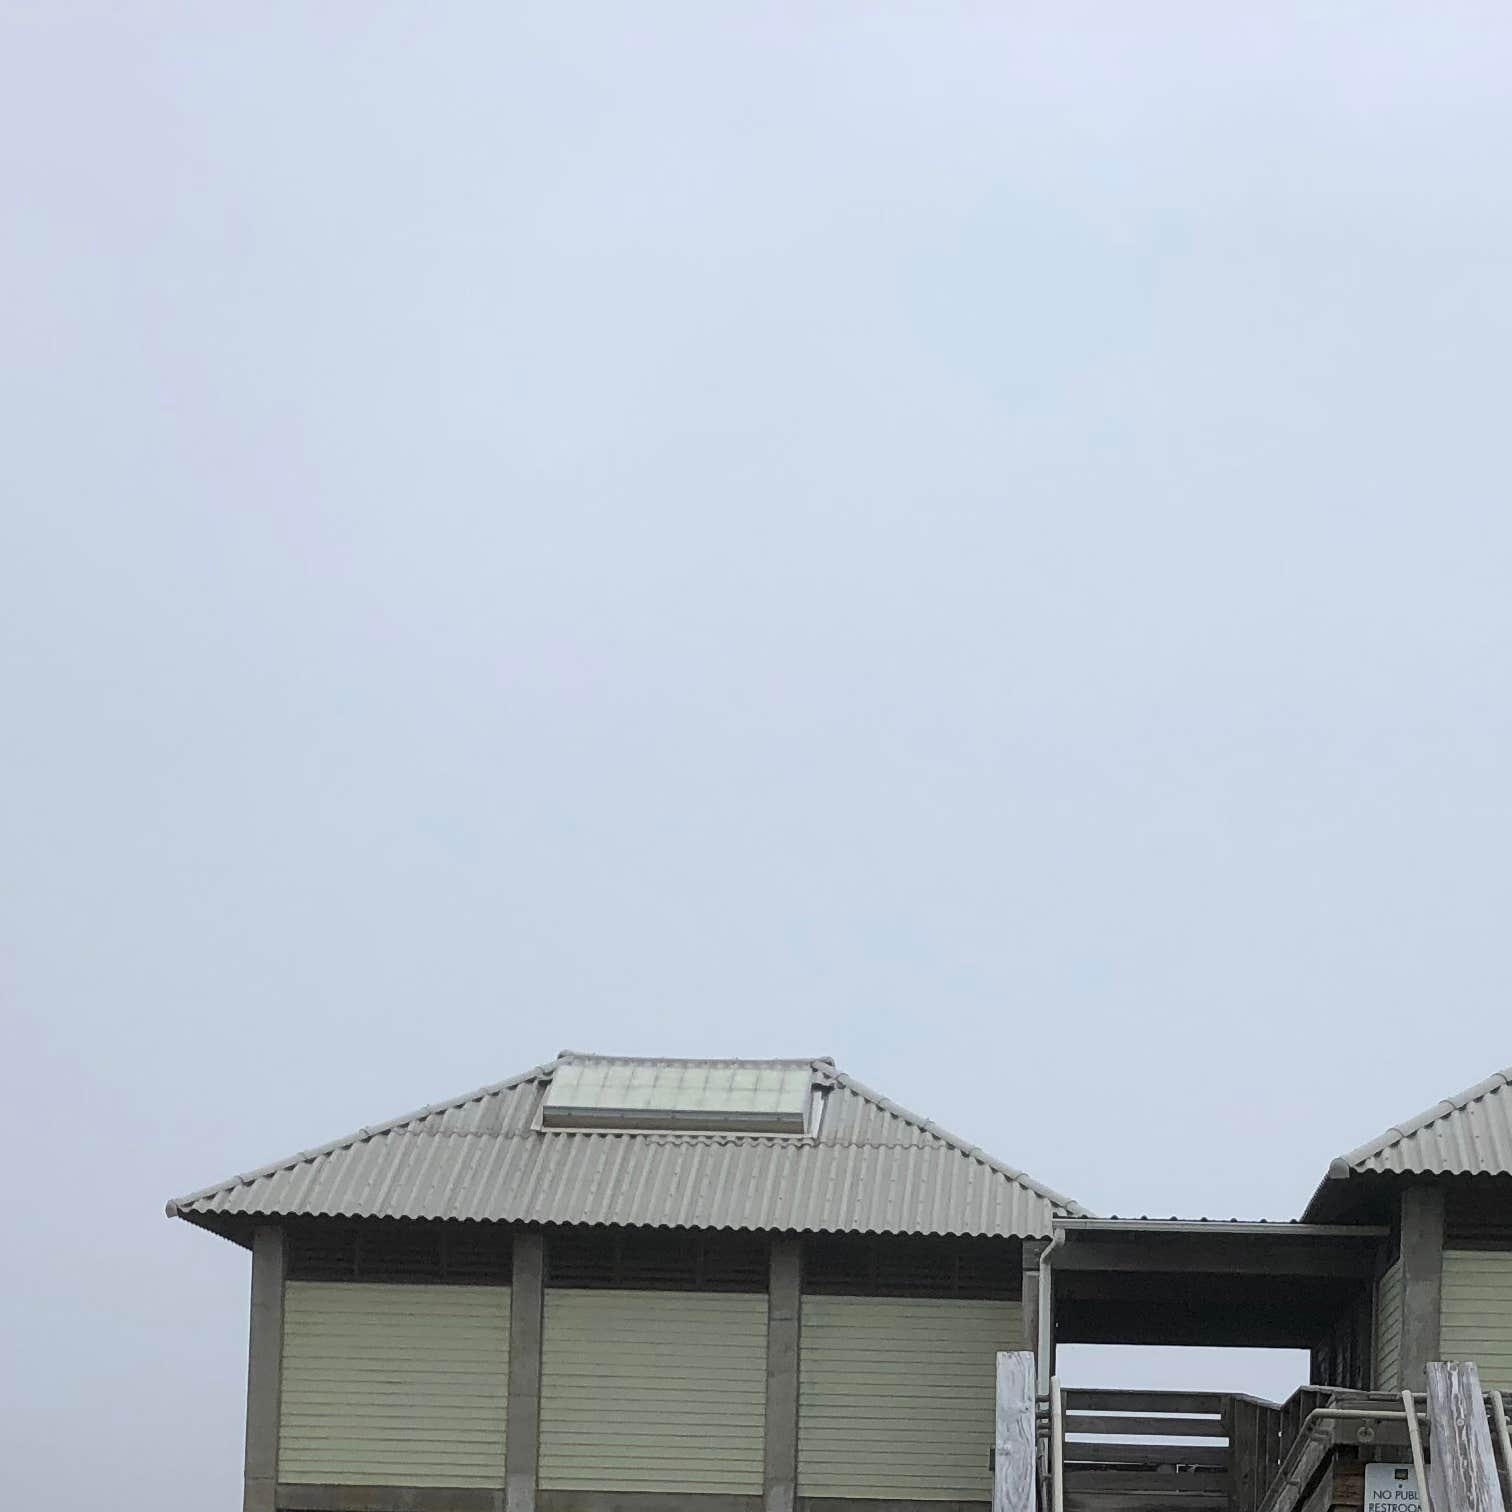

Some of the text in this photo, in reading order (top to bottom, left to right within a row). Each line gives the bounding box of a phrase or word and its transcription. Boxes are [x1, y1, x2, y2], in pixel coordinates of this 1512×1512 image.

[1373, 1490, 1419, 1500] NO PUBL
[1369, 1503, 1422, 1512] RESTROO
